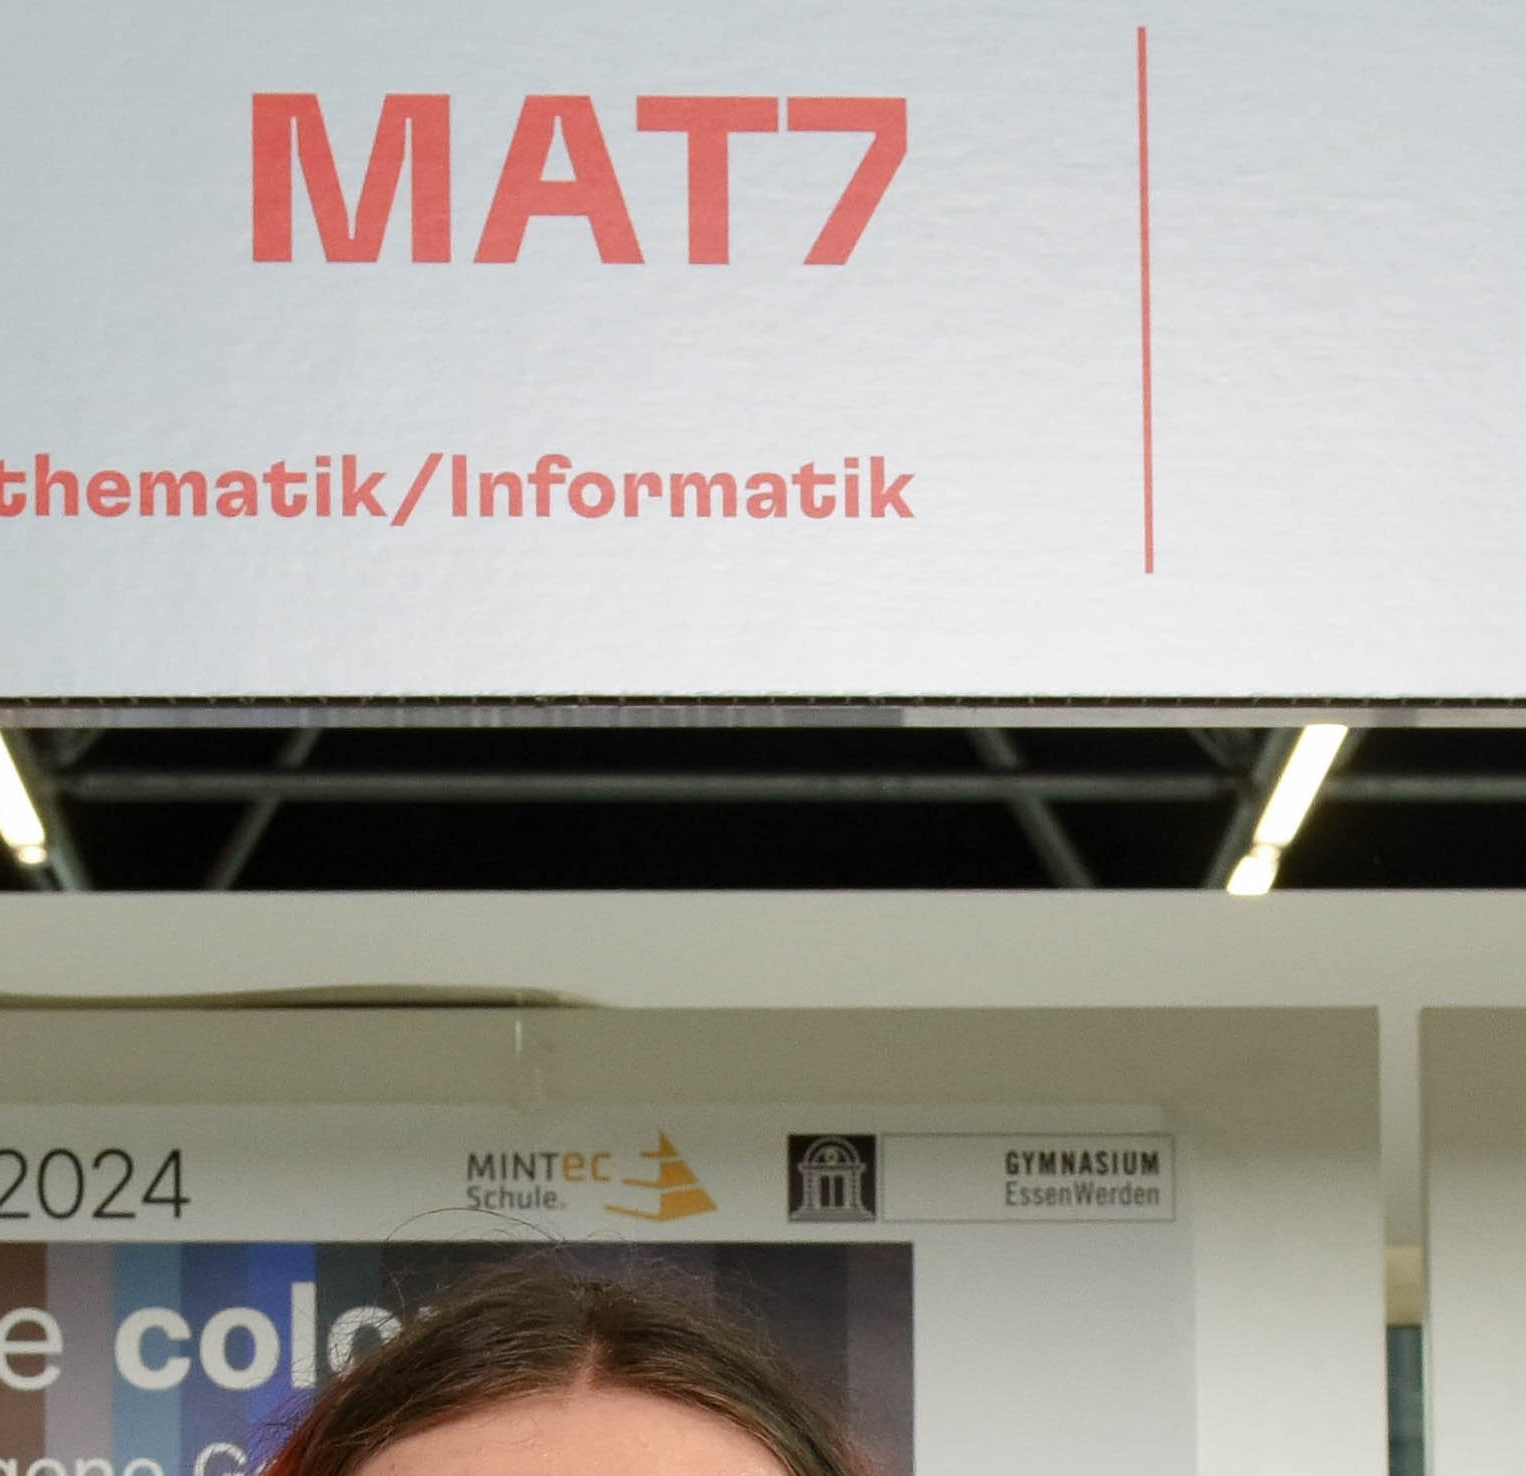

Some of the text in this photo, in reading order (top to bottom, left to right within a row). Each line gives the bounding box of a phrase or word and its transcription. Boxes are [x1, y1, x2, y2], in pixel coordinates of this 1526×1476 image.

[251, 92, 908, 265] MAT7
[1005, 1150, 1159, 1176] GYMNASIUM
[115, 1281, 438, 1392] colo
